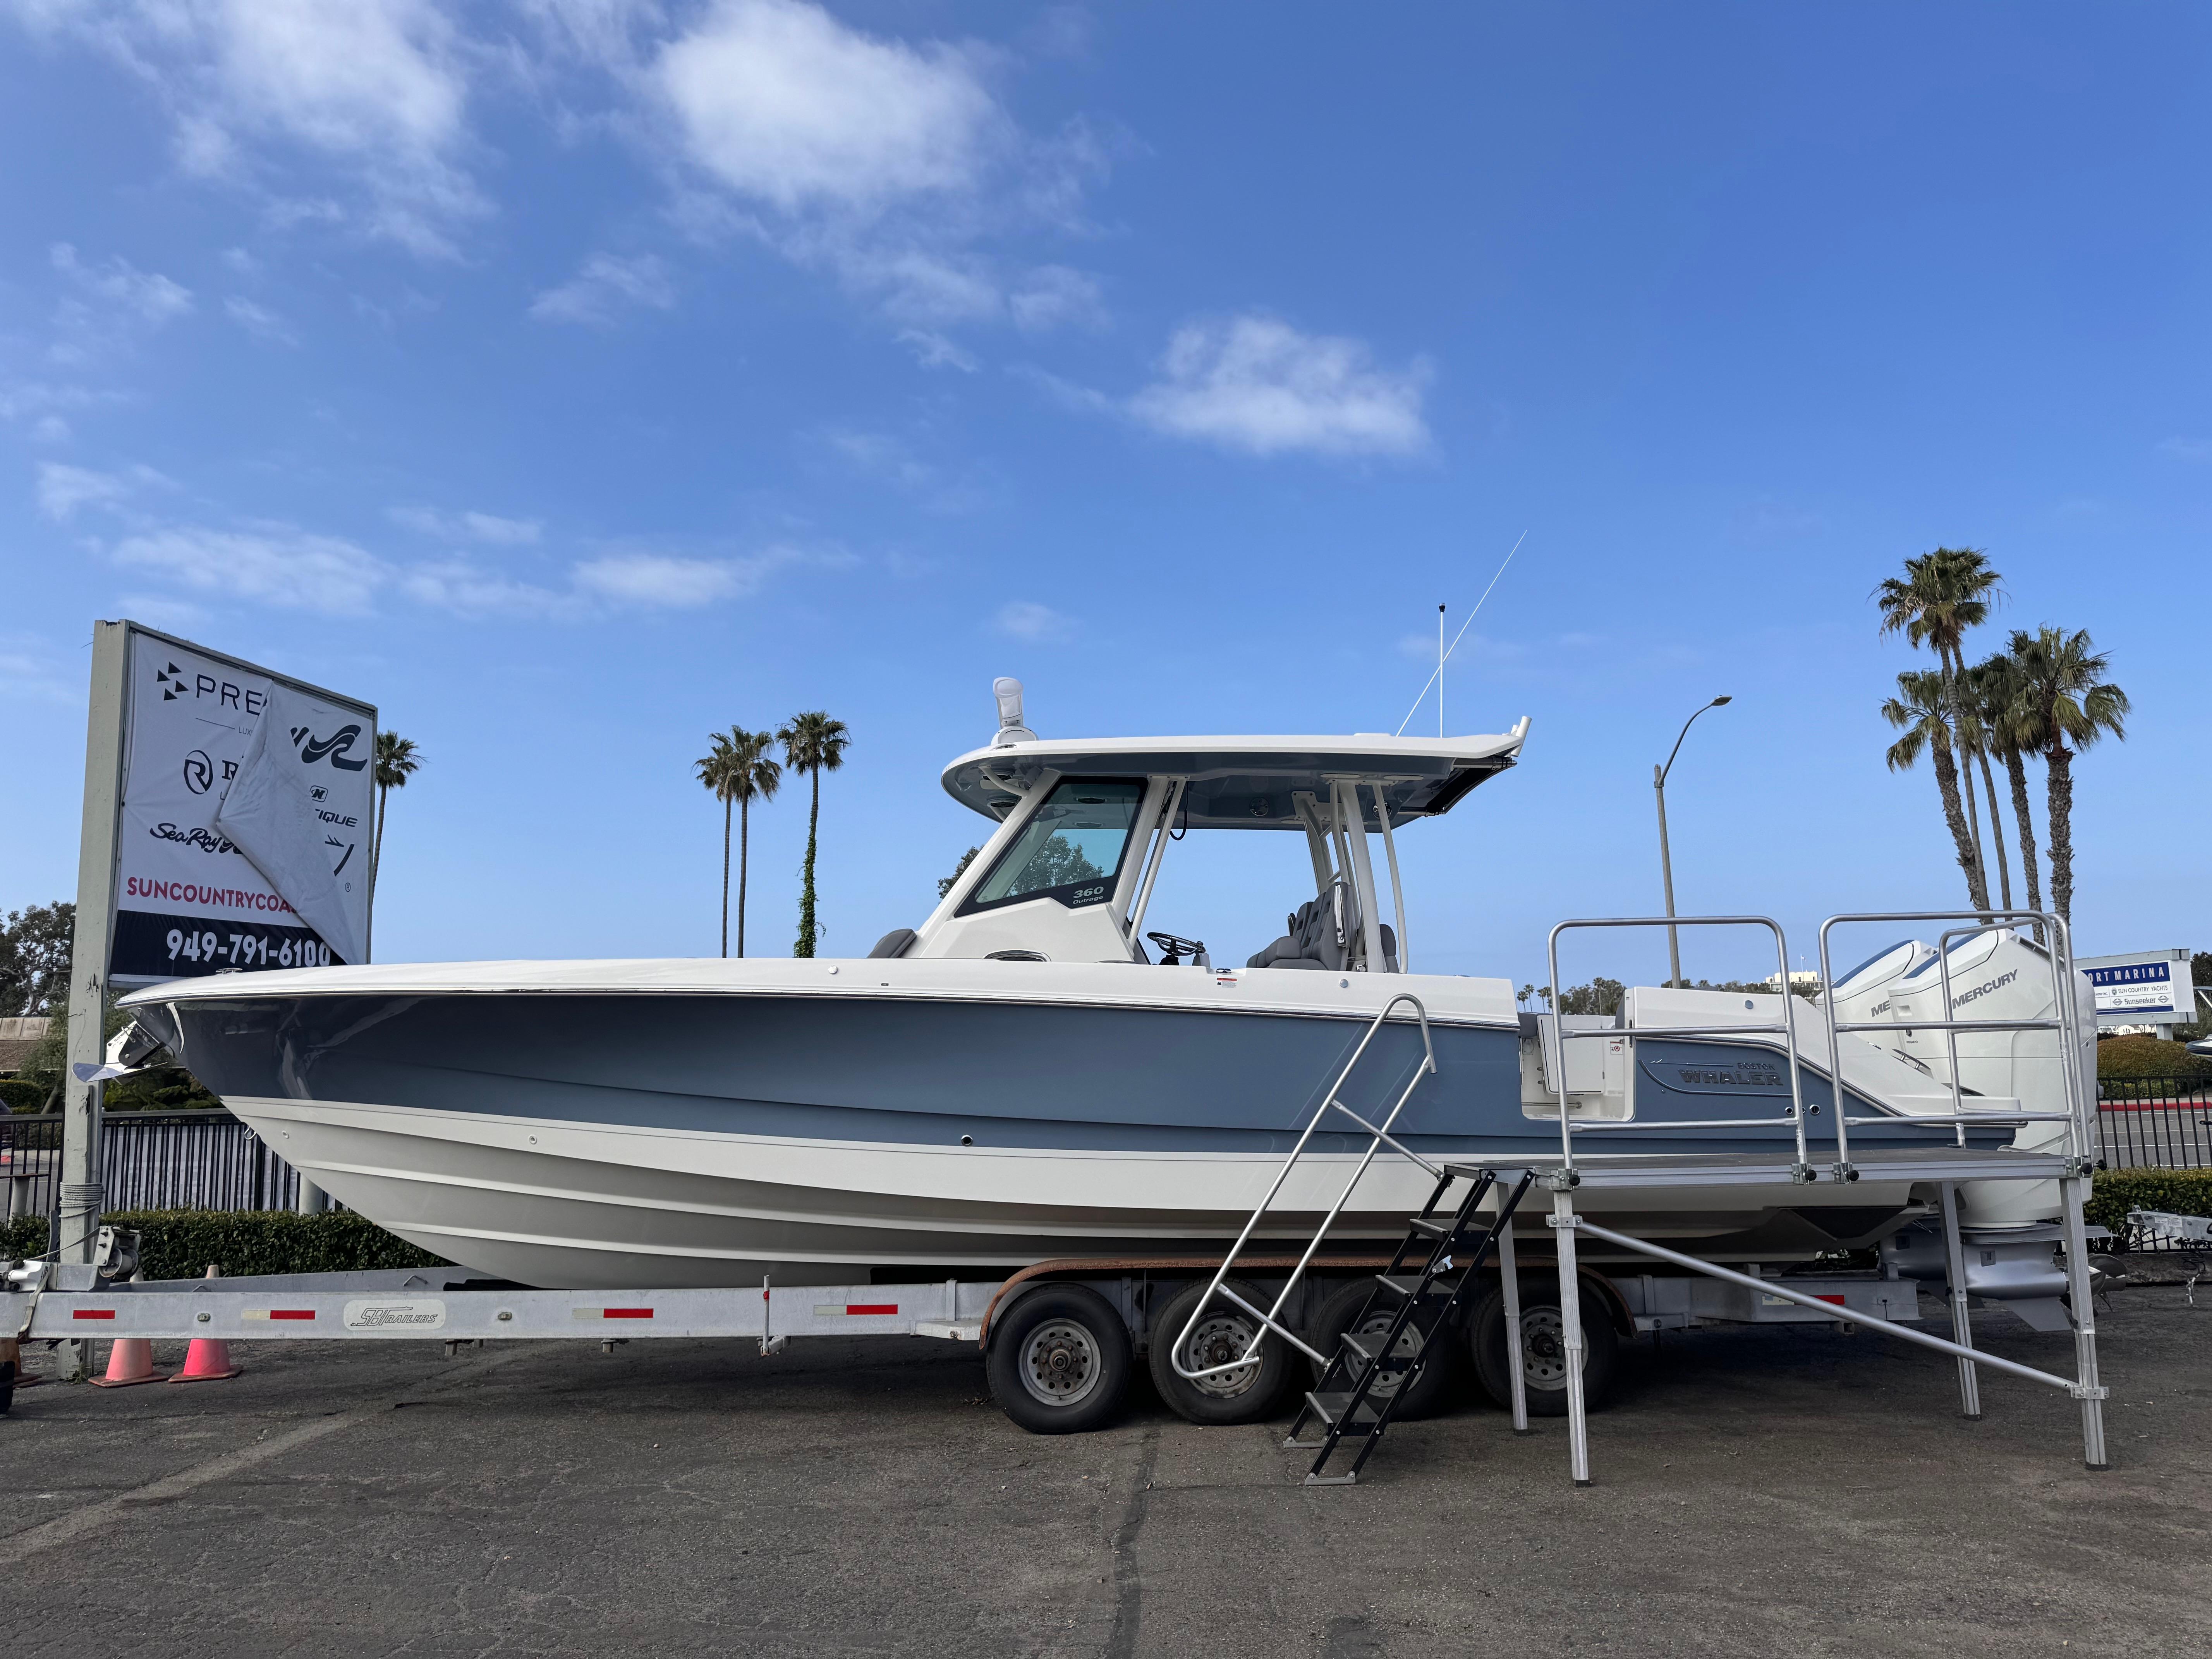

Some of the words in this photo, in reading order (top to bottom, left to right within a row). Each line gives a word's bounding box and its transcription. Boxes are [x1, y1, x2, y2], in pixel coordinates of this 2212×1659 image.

[196, 674, 267, 716] PRE
[239, 726, 252, 736] LUX
[149, 823, 189, 842] Sea
[186, 828, 222, 853] Ray
[127, 877, 297, 914] SUNCOUNTRYCOA
[1073, 886, 1104, 898] 360
[1073, 896, 1104, 904] Outrage
[167, 929, 331, 967] 949-791-6100
[2114, 967, 2165, 981] MARINA
[1952, 969, 2018, 1009] MERCURY
[1871, 1000, 1891, 1017] ME
[1677, 1068, 1783, 1086] WHALER
